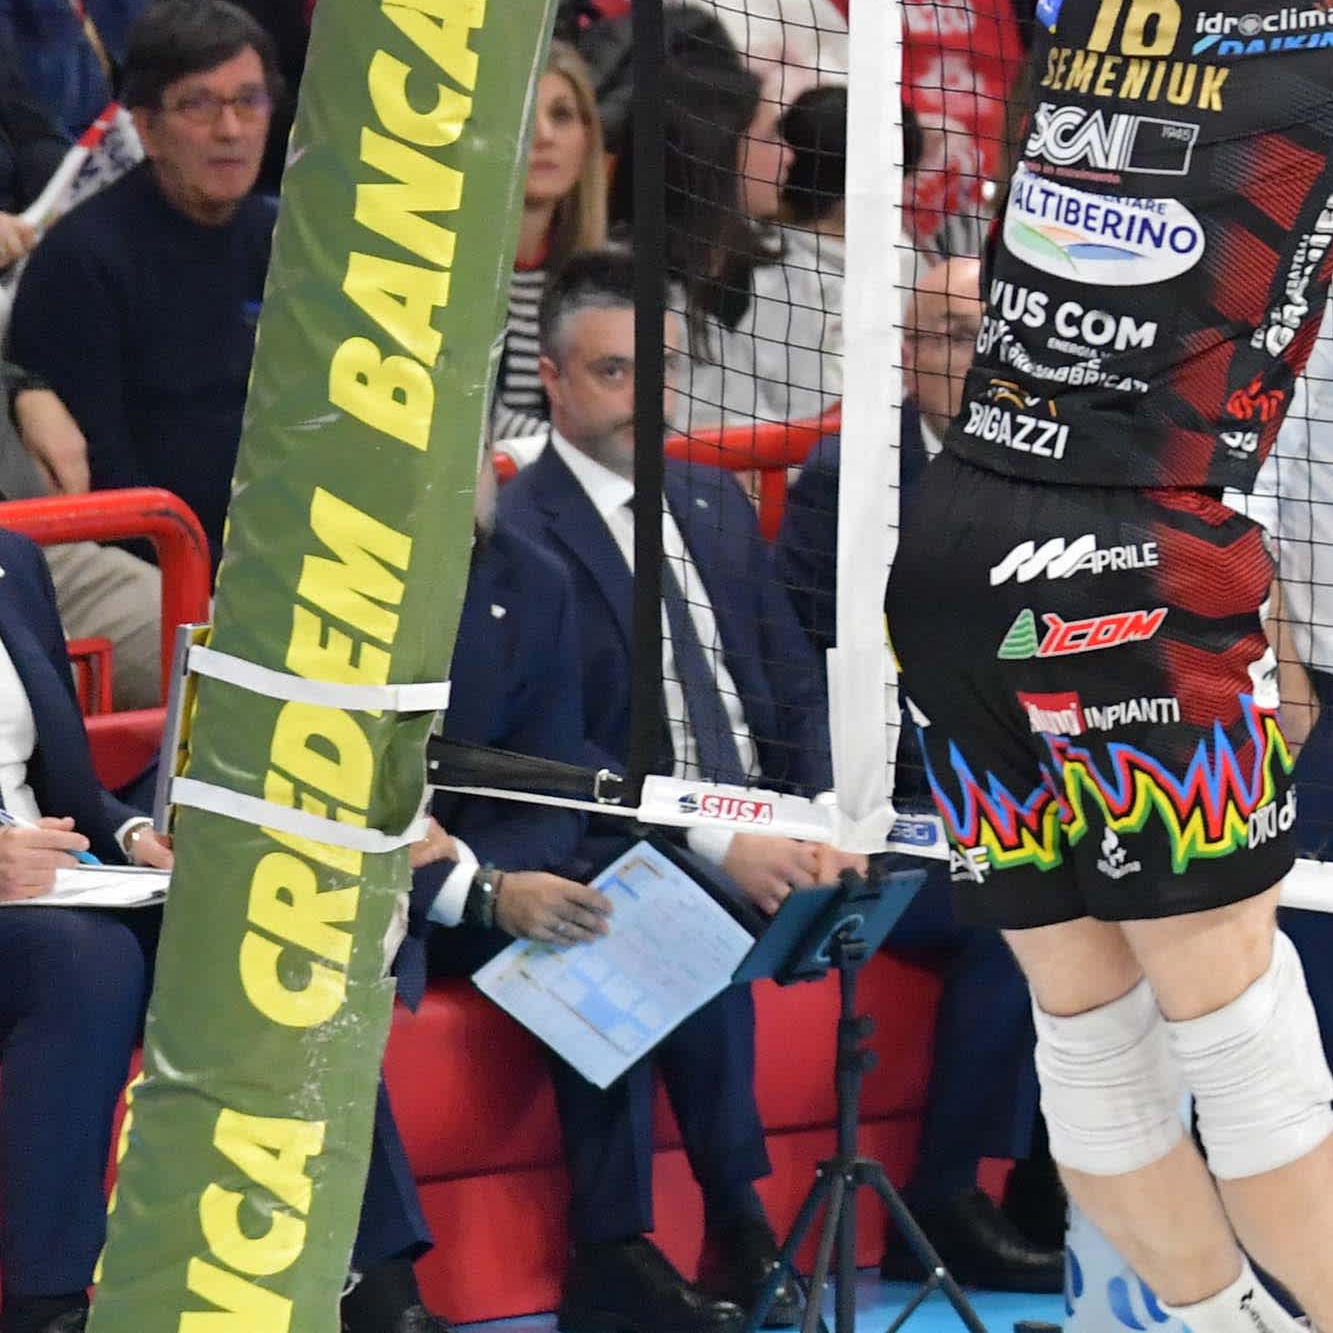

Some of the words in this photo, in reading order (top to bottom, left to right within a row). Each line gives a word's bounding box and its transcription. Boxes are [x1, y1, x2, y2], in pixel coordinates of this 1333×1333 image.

[1040, 46, 1230, 113] SEMENIUK
[1054, 301, 1159, 352] COM
[963, 401, 1070, 460] BIGAZZI
[239, 486, 413, 1028] CREDEM
[700, 796, 772, 824] SUSA
